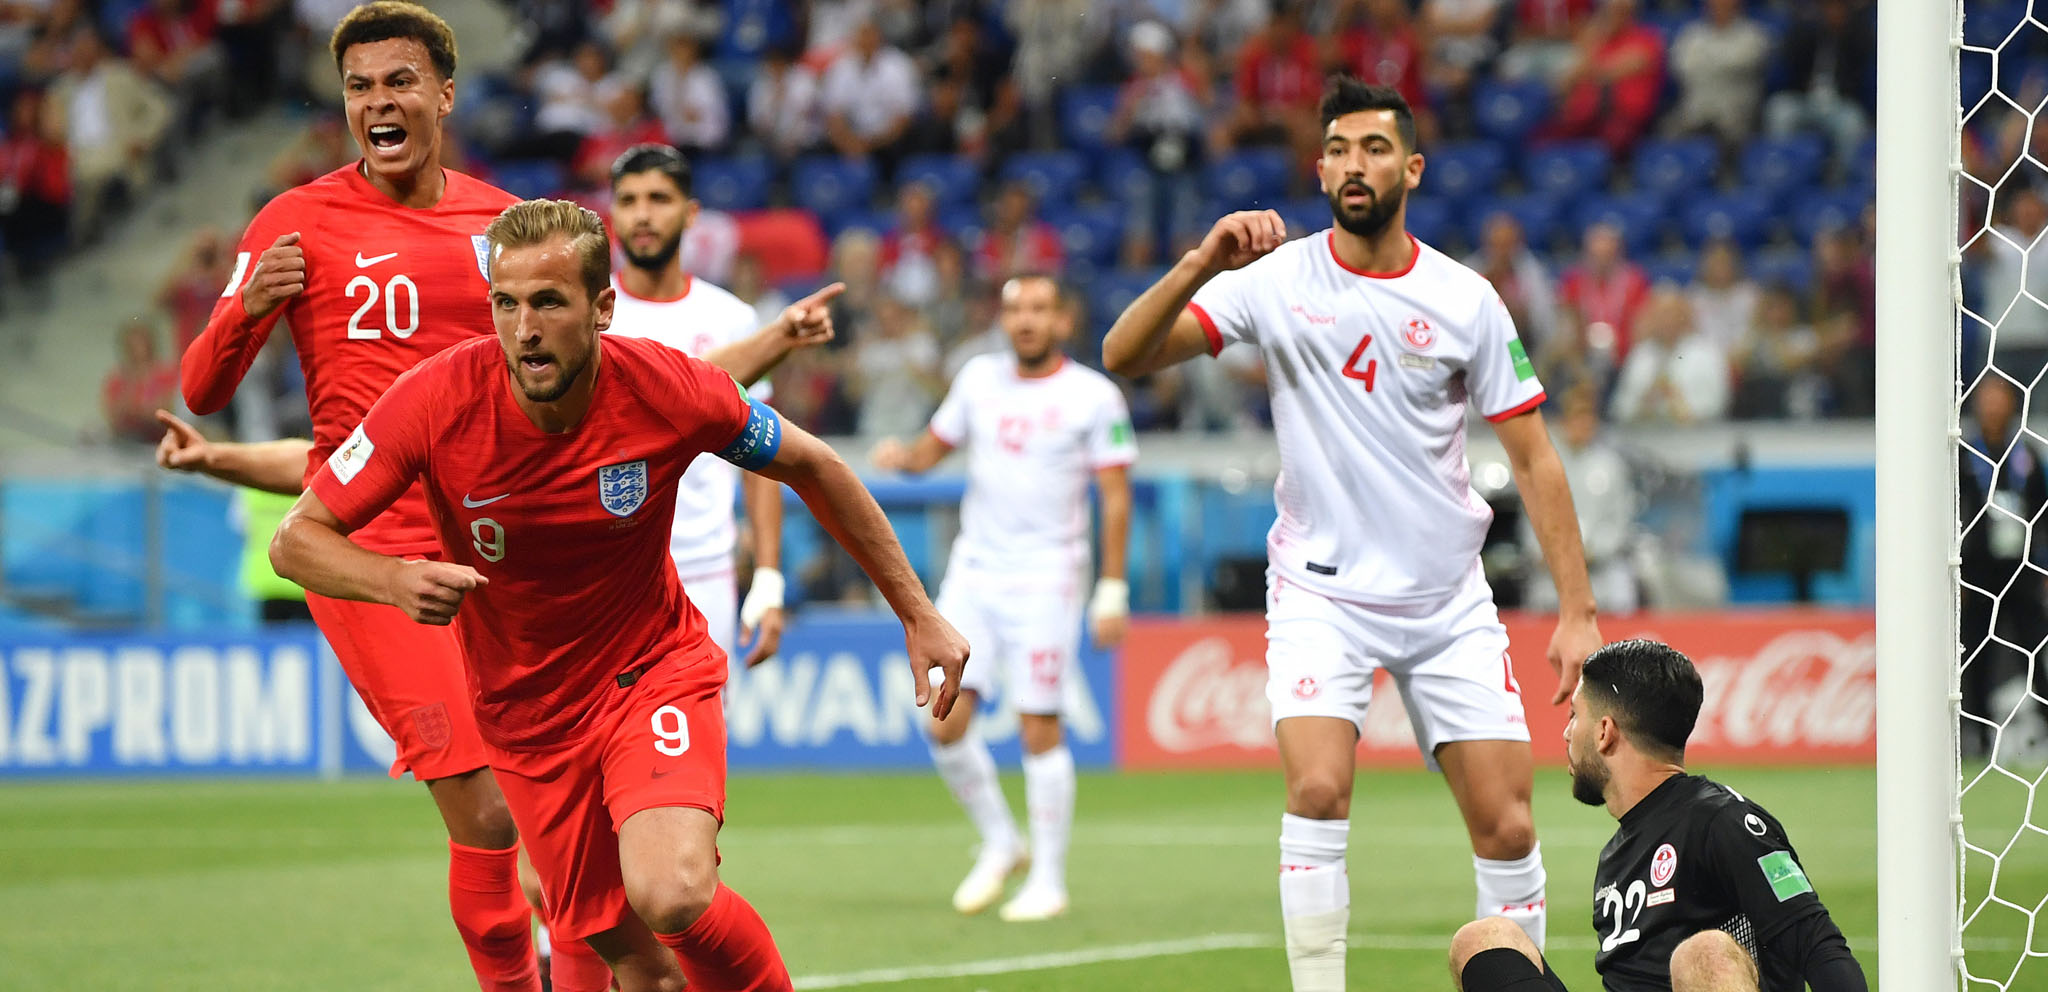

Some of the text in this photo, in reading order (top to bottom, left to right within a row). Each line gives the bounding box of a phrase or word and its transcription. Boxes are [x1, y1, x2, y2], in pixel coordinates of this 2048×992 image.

[345, 274, 420, 340] 20
[1342, 334, 1377, 392] 4
[764, 418, 775, 447] FIFA
[470, 517, 505, 563] 9
[0, 646, 311, 765] ZPROM
[650, 704, 691, 757] 9
[1602, 879, 1647, 953] 22
